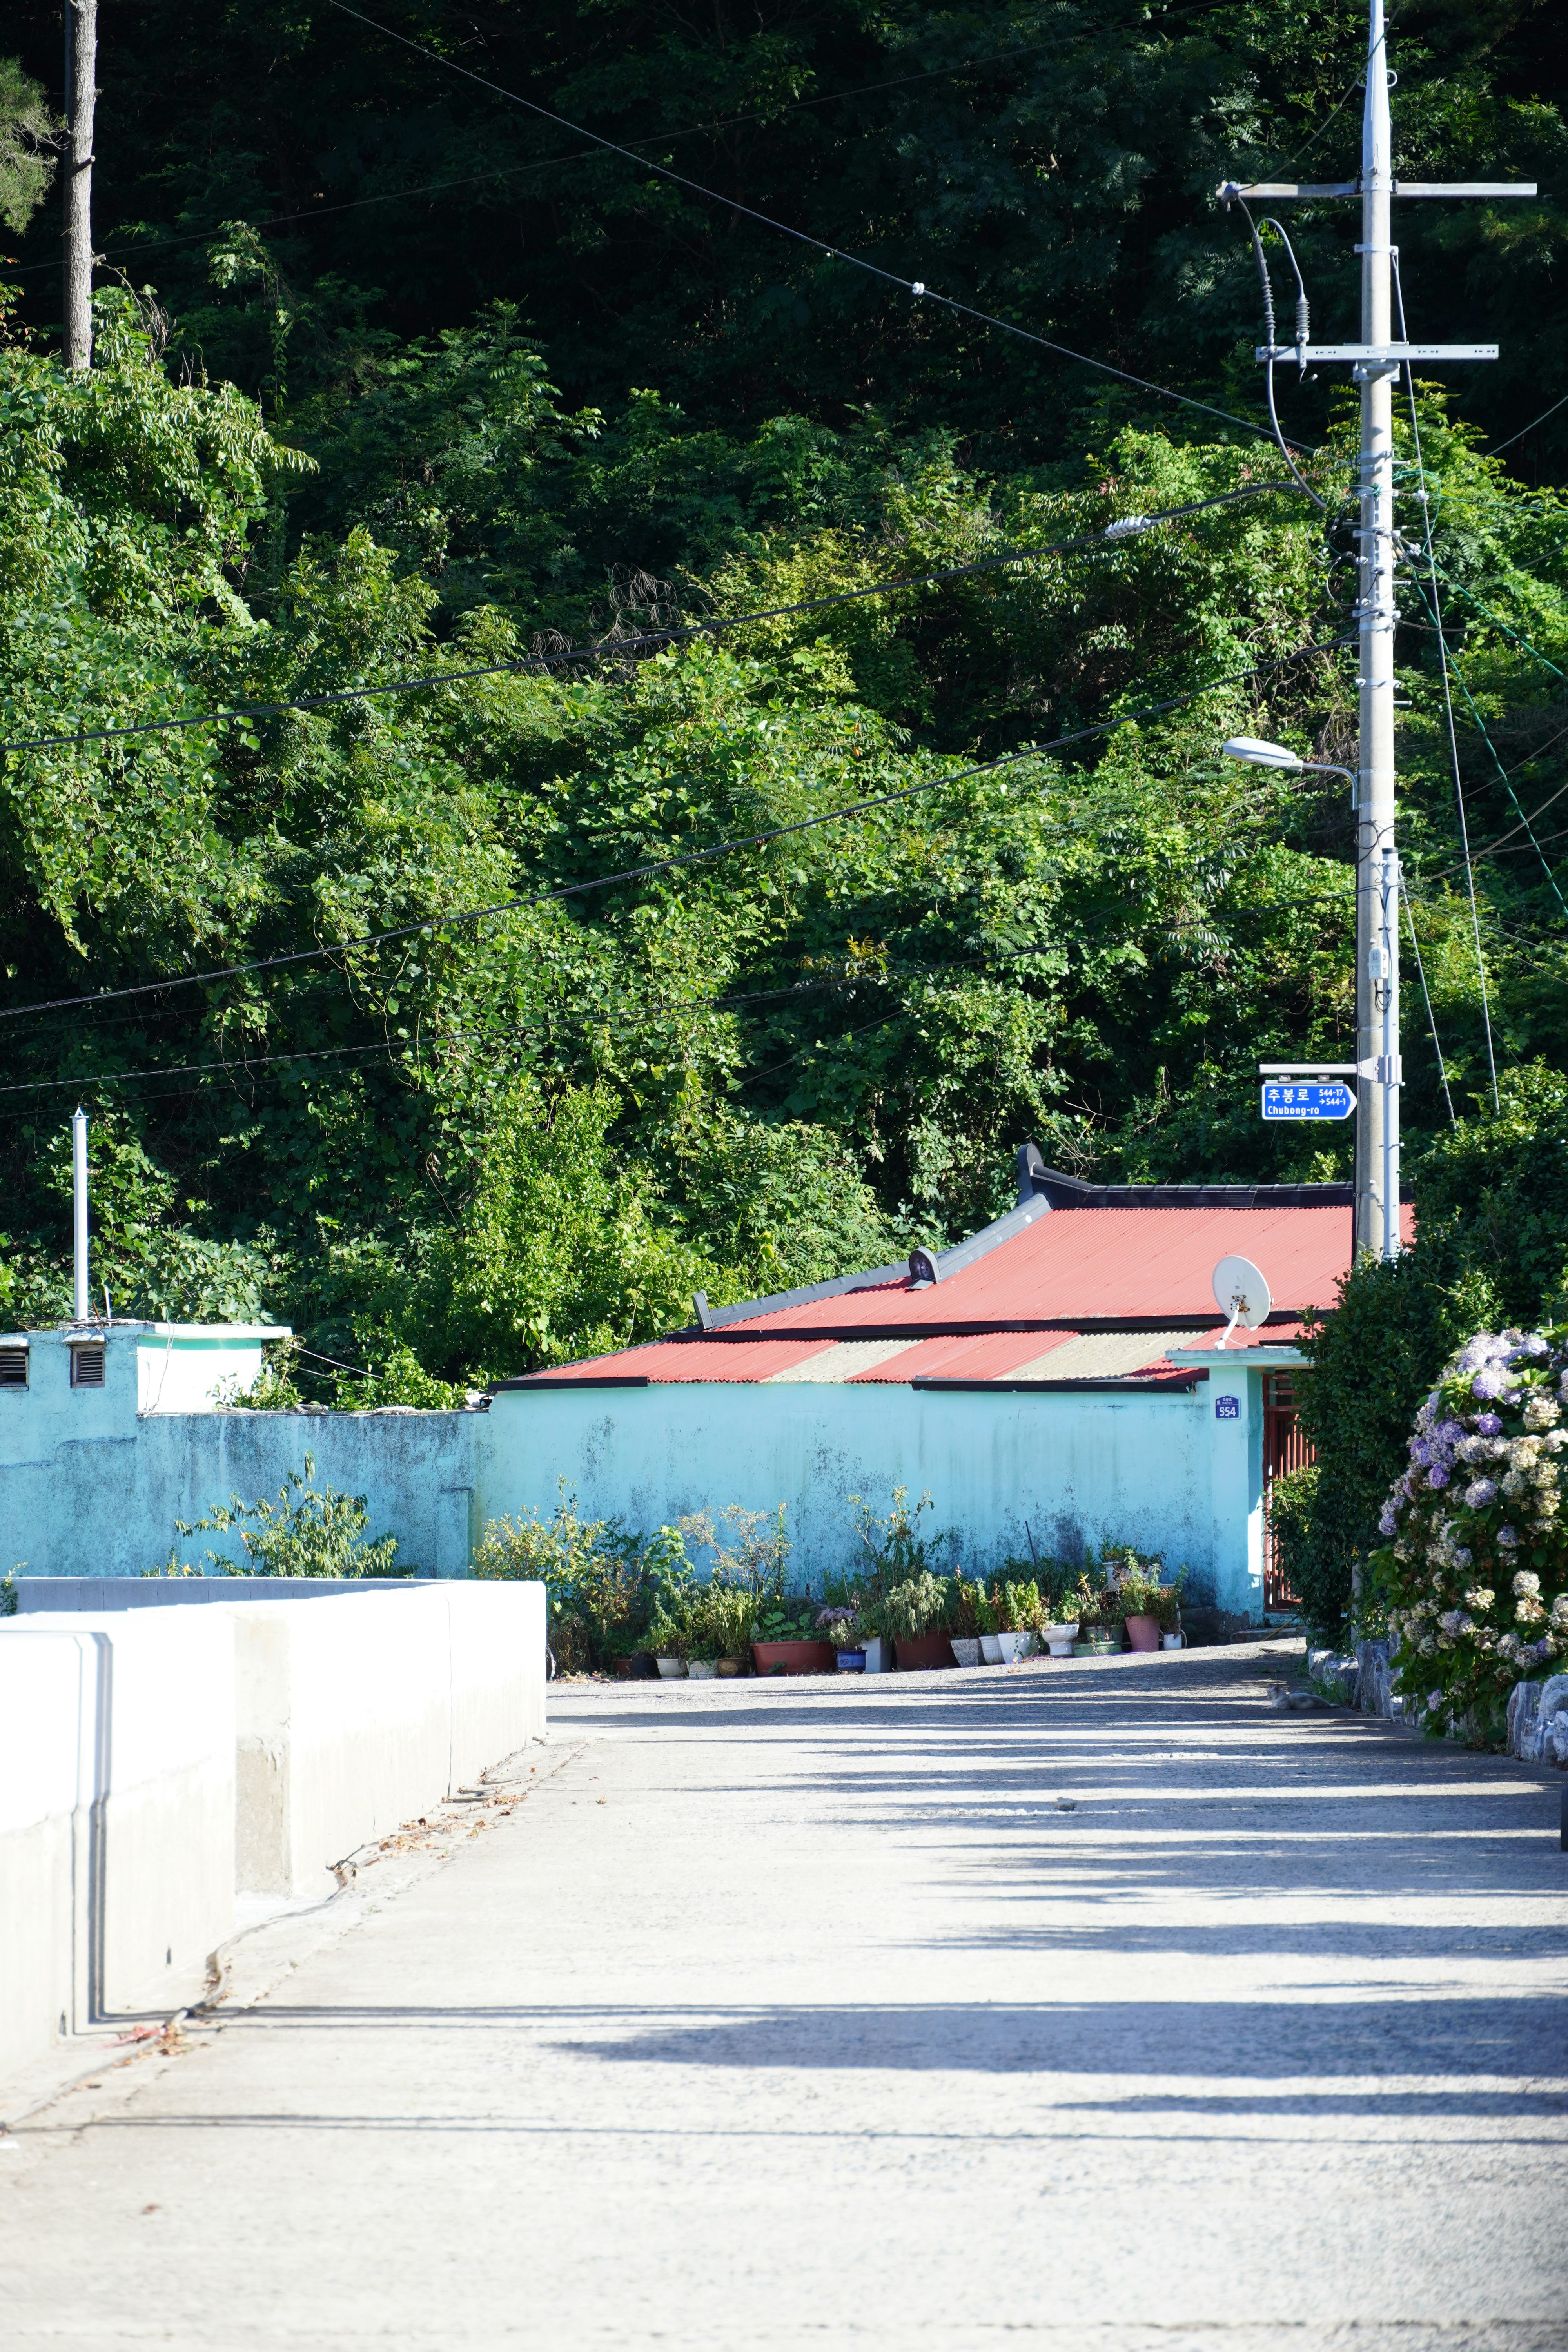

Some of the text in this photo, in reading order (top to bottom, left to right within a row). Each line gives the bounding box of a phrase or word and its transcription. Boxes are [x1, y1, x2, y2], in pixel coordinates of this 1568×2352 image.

[1268, 1089, 1309, 1103] 추봉로
[1268, 1106, 1319, 1116] Chubong-ro
[1220, 1407, 1236, 1417] 554
